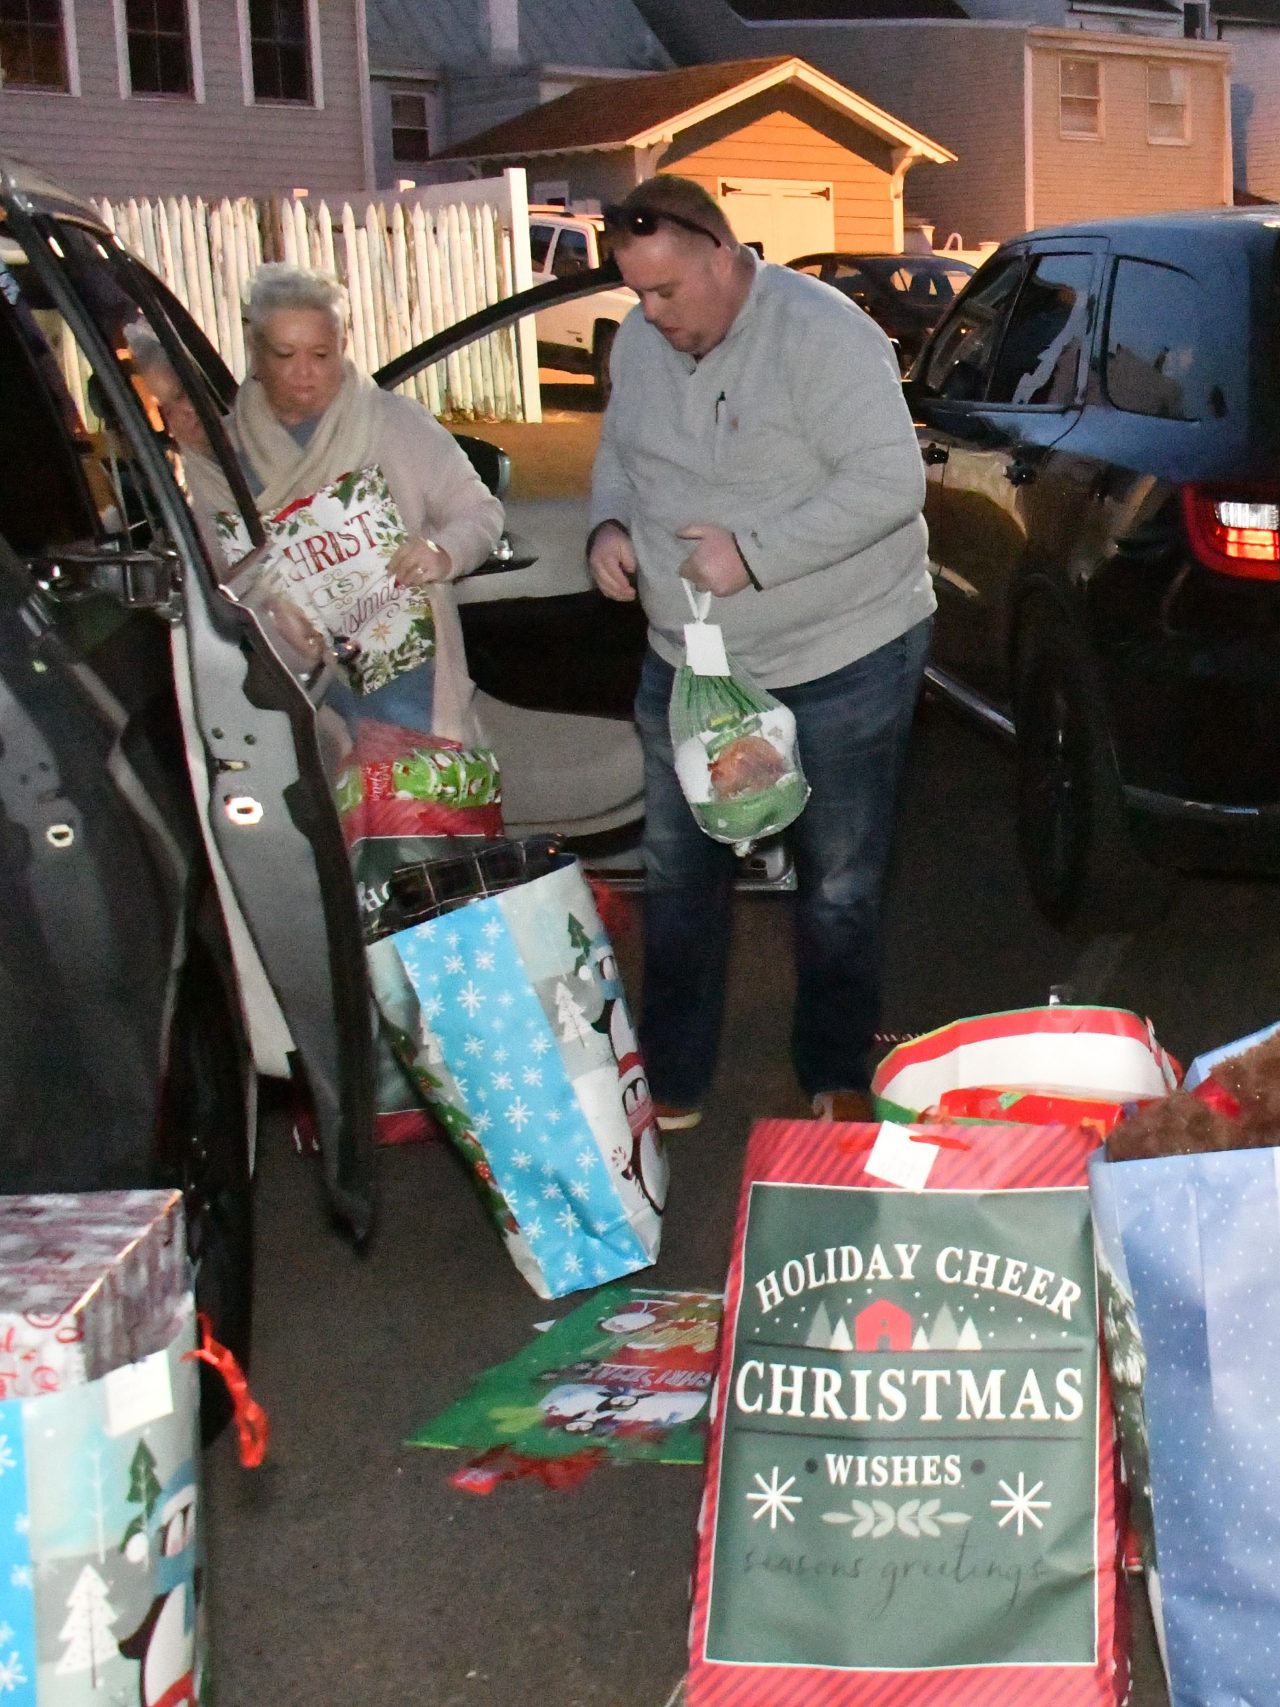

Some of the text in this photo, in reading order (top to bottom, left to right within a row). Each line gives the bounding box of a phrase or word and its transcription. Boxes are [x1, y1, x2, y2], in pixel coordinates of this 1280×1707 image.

[325, 579, 353, 599] IS
[756, 1244, 1082, 1320] HOLIDAY CHEER
[735, 1359, 1084, 1421] CHRISTMAS
[825, 1453, 962, 1486] WISHES
